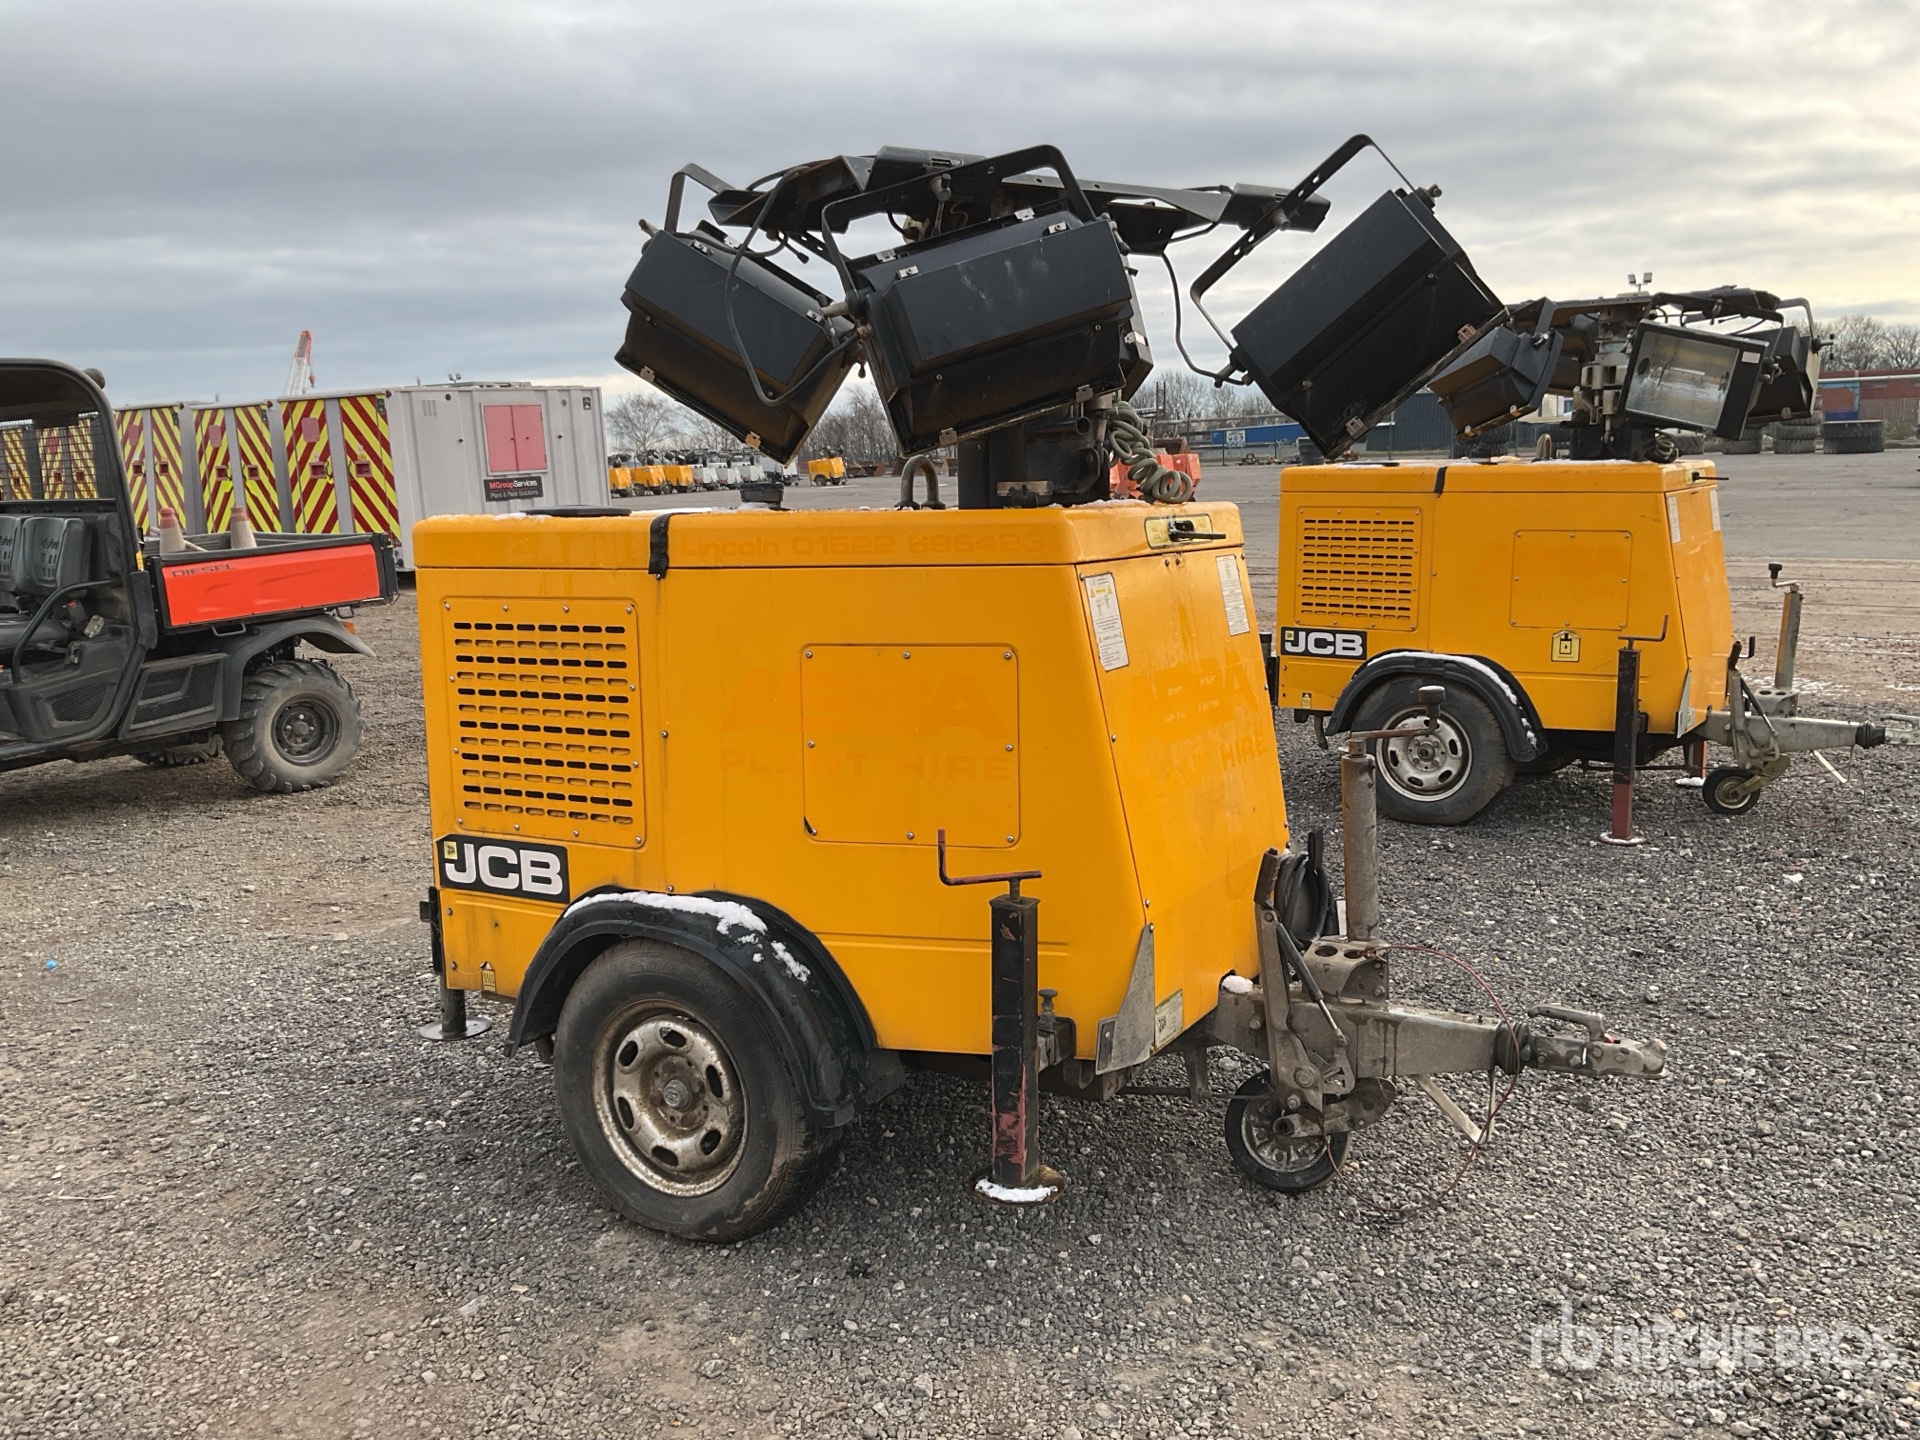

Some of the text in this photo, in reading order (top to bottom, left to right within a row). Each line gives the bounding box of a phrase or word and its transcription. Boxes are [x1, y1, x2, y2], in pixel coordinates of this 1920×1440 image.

[681, 533, 1044, 557] Lincoln 01522 696423
[171, 564, 238, 577] DIESEL
[1284, 631, 1363, 657] JCB
[720, 749, 1010, 781] PLANT HIRE
[445, 843, 563, 895] JCB
